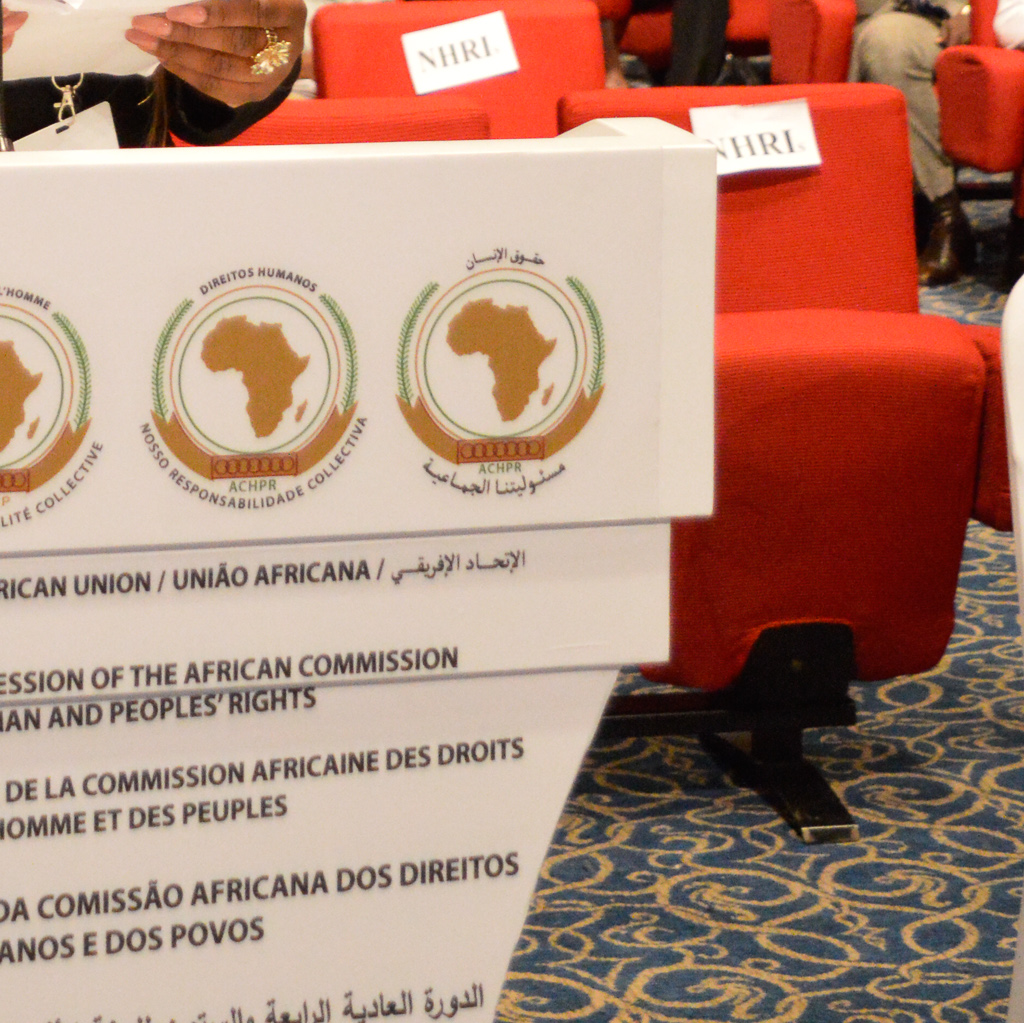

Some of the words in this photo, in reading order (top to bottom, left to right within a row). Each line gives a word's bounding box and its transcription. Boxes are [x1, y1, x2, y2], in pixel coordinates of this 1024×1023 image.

[510, 250, 545, 266] حقوق
[200, 268, 254, 295] DIREITOS
[258, 267, 318, 293] HUMANOS
[36, 441, 103, 514] COLLECTIVE
[140, 423, 170, 469] NOSSO
[169, 468, 305, 509] RESPONSABILIDADE
[308, 416, 367, 490] COLLECTIVA
[479, 462, 522, 474] ACHPR
[229, 479, 276, 492] ACHPR
[74, 571, 151, 596] UNION
[157, 570, 166, 593] /
[174, 562, 248, 591] UNIÃO
[254, 559, 371, 586] AFRICANA
[376, 558, 385, 580] /
[91, 666, 124, 690] OF
[130, 663, 177, 687] THE
[184, 656, 291, 684] AFRICAN
[298, 647, 459, 677] COMMISSION
[48, 702, 102, 729] AND
[110, 693, 224, 724] PEOPLES'
[229, 687, 317, 715] RIGHTS
[6, 778, 38, 803] DE
[45, 776, 75, 800] LA
[82, 762, 245, 796] COMMISSION
[251, 750, 379, 783] AFRICAINE
[386, 745, 430, 771] DES
[437, 737, 524, 766] DROITS
[93, 808, 122, 833] ET
[129, 803, 175, 829] DES
[182, 794, 288, 825] PEUPLES
[37, 879, 183, 919] COMISSÃO
[191, 871, 329, 906] AFRICANA
[336, 863, 392, 893] DOS
[399, 852, 519, 886] DIREITOS
[83, 932, 98, 957] E
[106, 926, 163, 955] DOS
[171, 916, 265, 948] POVOS
[424, 982, 484, 1020] الدورة
